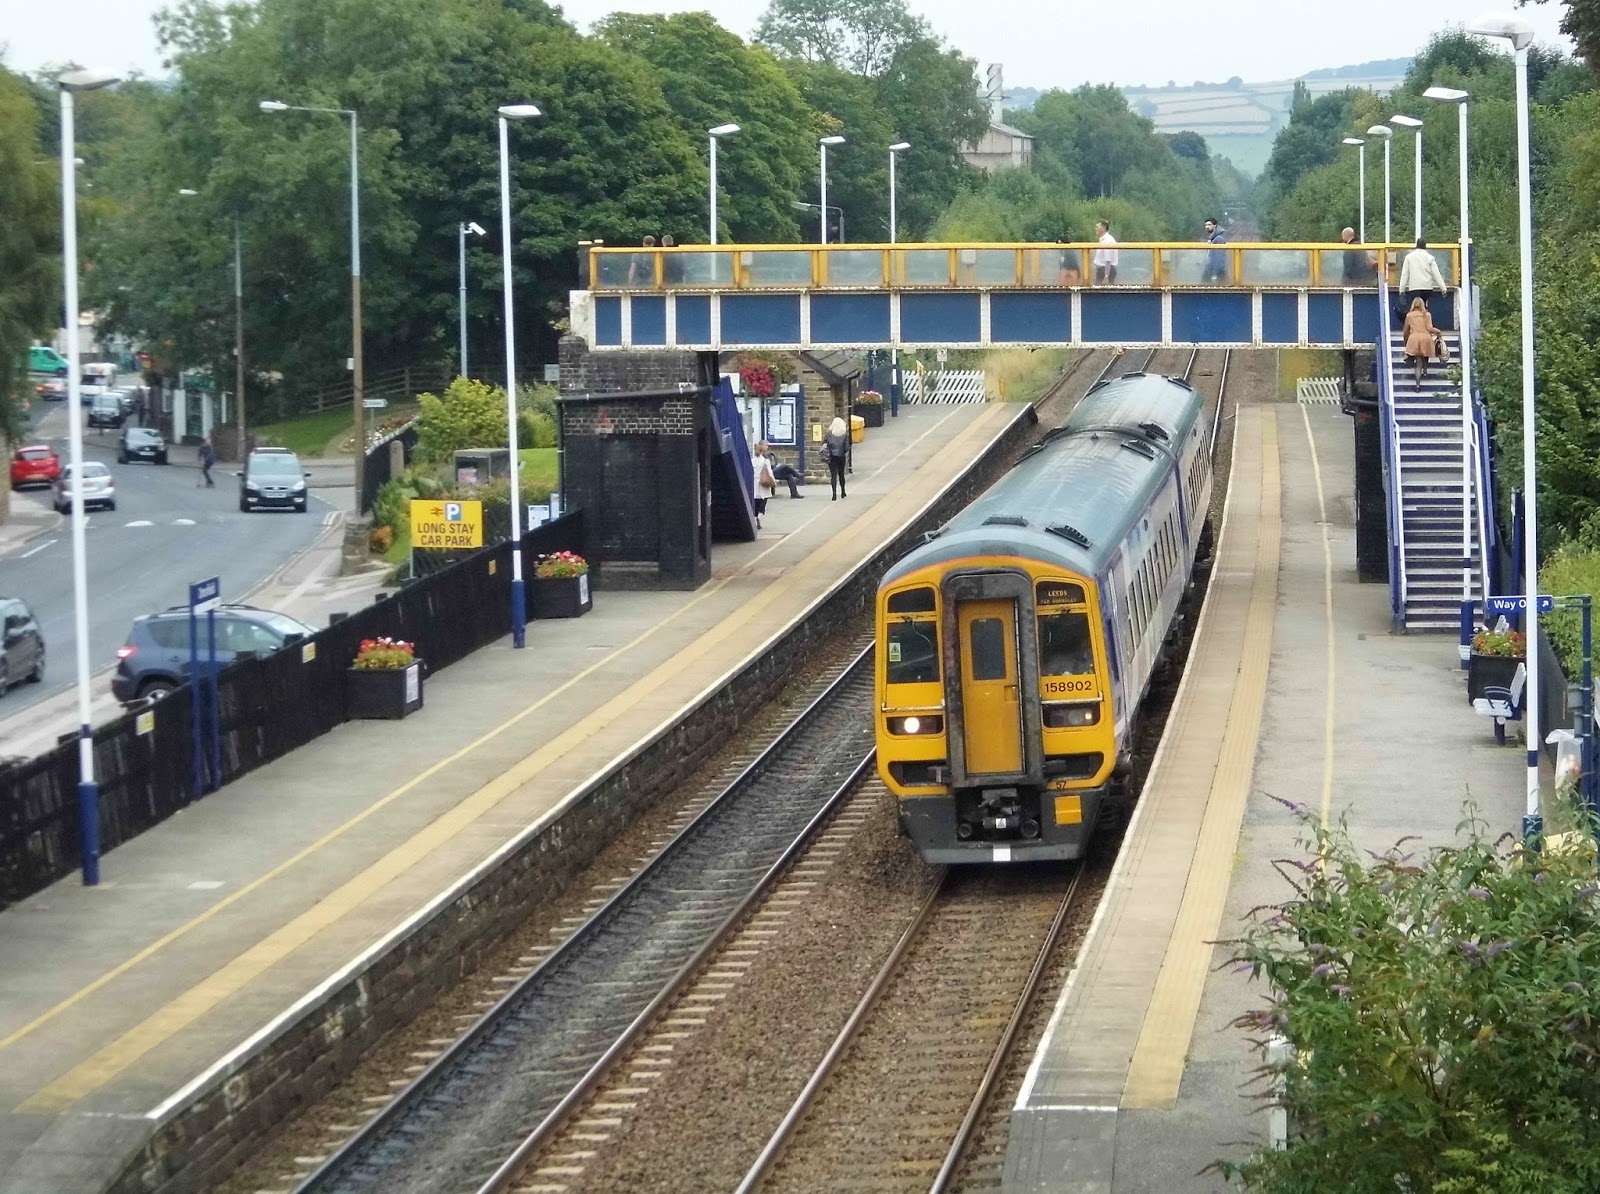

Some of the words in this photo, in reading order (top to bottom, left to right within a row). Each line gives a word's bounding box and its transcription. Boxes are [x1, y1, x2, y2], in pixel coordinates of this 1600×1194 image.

[417, 523, 446, 534] LONG
[449, 523, 475, 534] STAY
[420, 535, 442, 546] CAR
[445, 535, 472, 546] PARK
[1493, 600, 1516, 610] Way
[1045, 680, 1092, 693] 158902
[1056, 780, 1066, 790] 57
